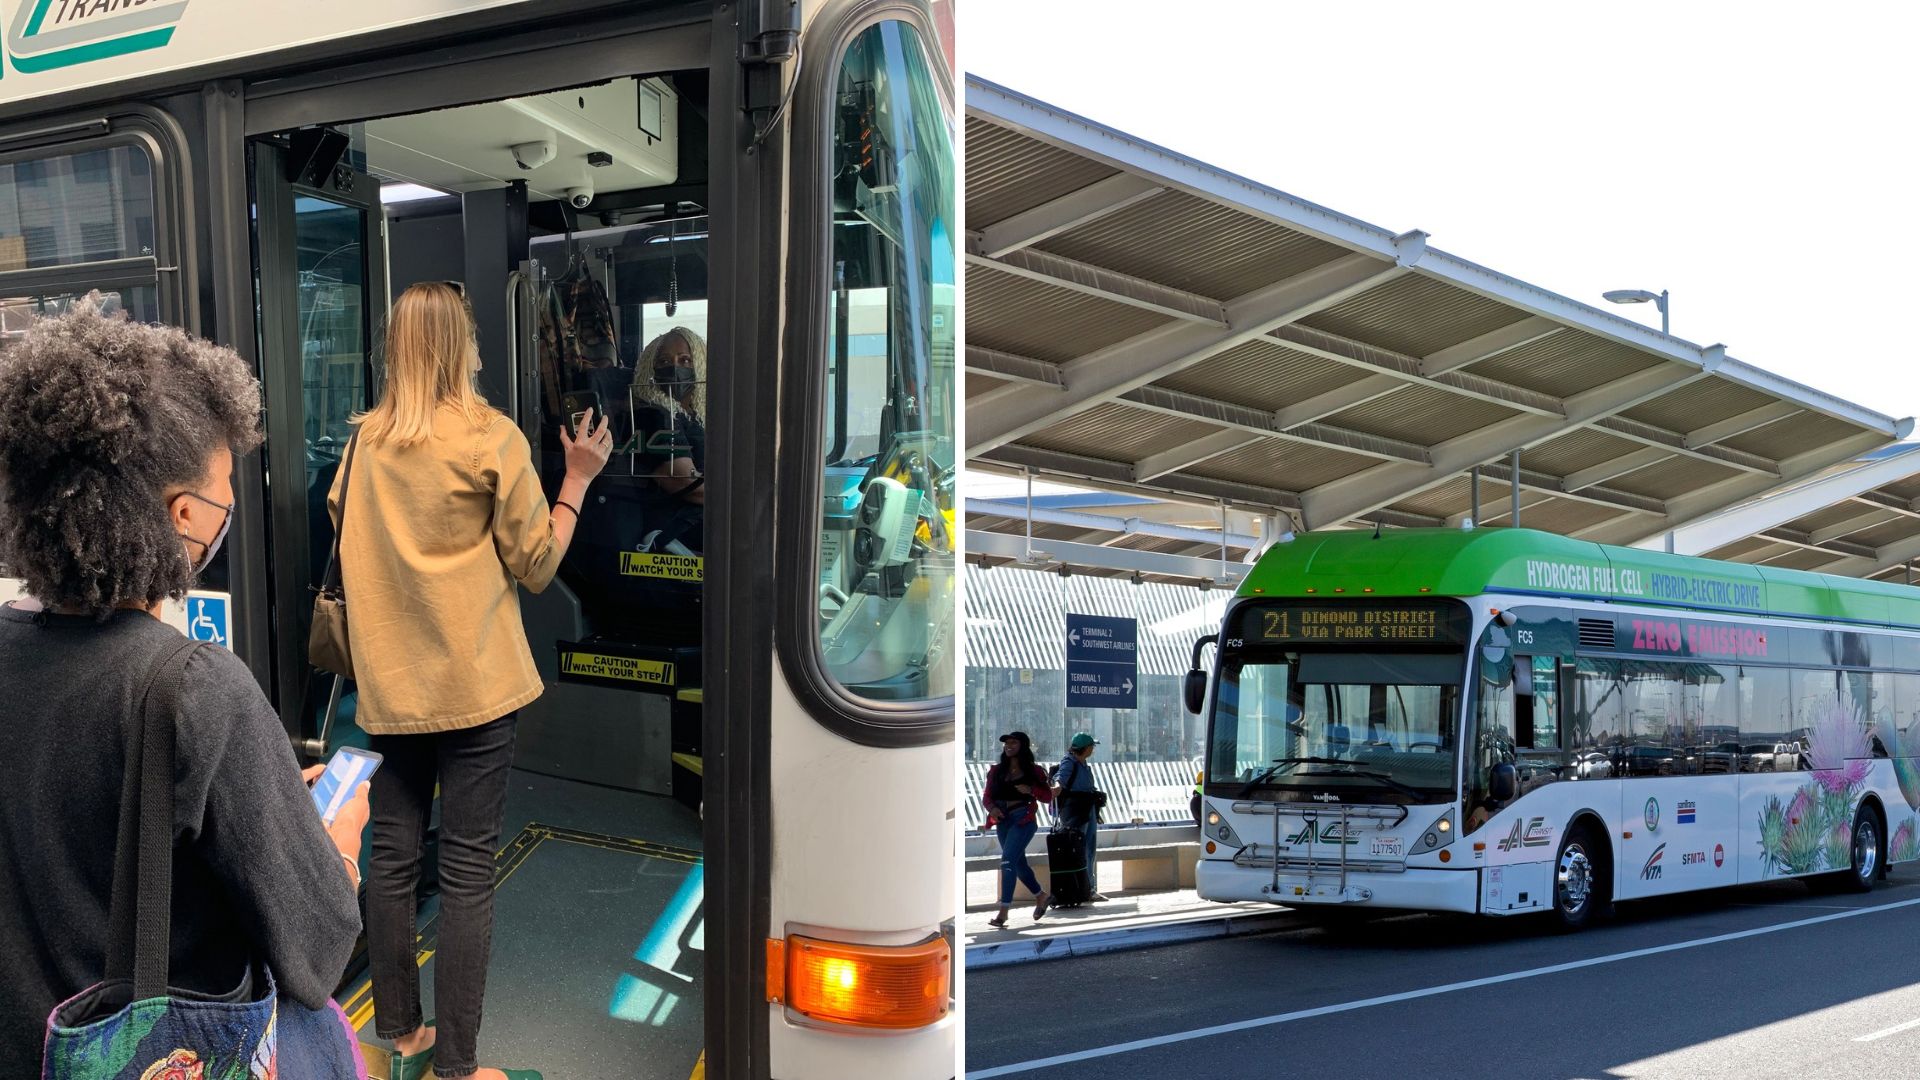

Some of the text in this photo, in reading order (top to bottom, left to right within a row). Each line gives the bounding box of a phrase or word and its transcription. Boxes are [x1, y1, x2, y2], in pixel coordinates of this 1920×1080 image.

[652, 556, 698, 567] CAUTION
[631, 564, 664, 575] WATCH
[667, 567, 694, 578] YOUR
[1527, 560, 1760, 608] HYDROGEN FUEL CELL HYBRID-ELECTRIC DRIVE
[1302, 611, 1436, 624] DIMOND DISTRICT
[1264, 611, 1291, 638] 21
[1082, 627, 1112, 637] TERMINAL 2
[1302, 626, 1436, 638] VIA PARK STREET
[1517, 630, 1533, 644] FC5
[1632, 619, 1768, 657] ZERO EMISSION
[1082, 639, 1135, 651] SOUTHWEST AIRLINES
[1226, 639, 1243, 648] FC5
[593, 656, 638, 669] CAUTION
[572, 663, 661, 681] WATCH YOUR STEP
[1070, 673, 1101, 683] TERMINAL 1
[1070, 685, 1120, 696] ALL OTHER AIRLINES
[1682, 851, 1706, 865] SFMTA
